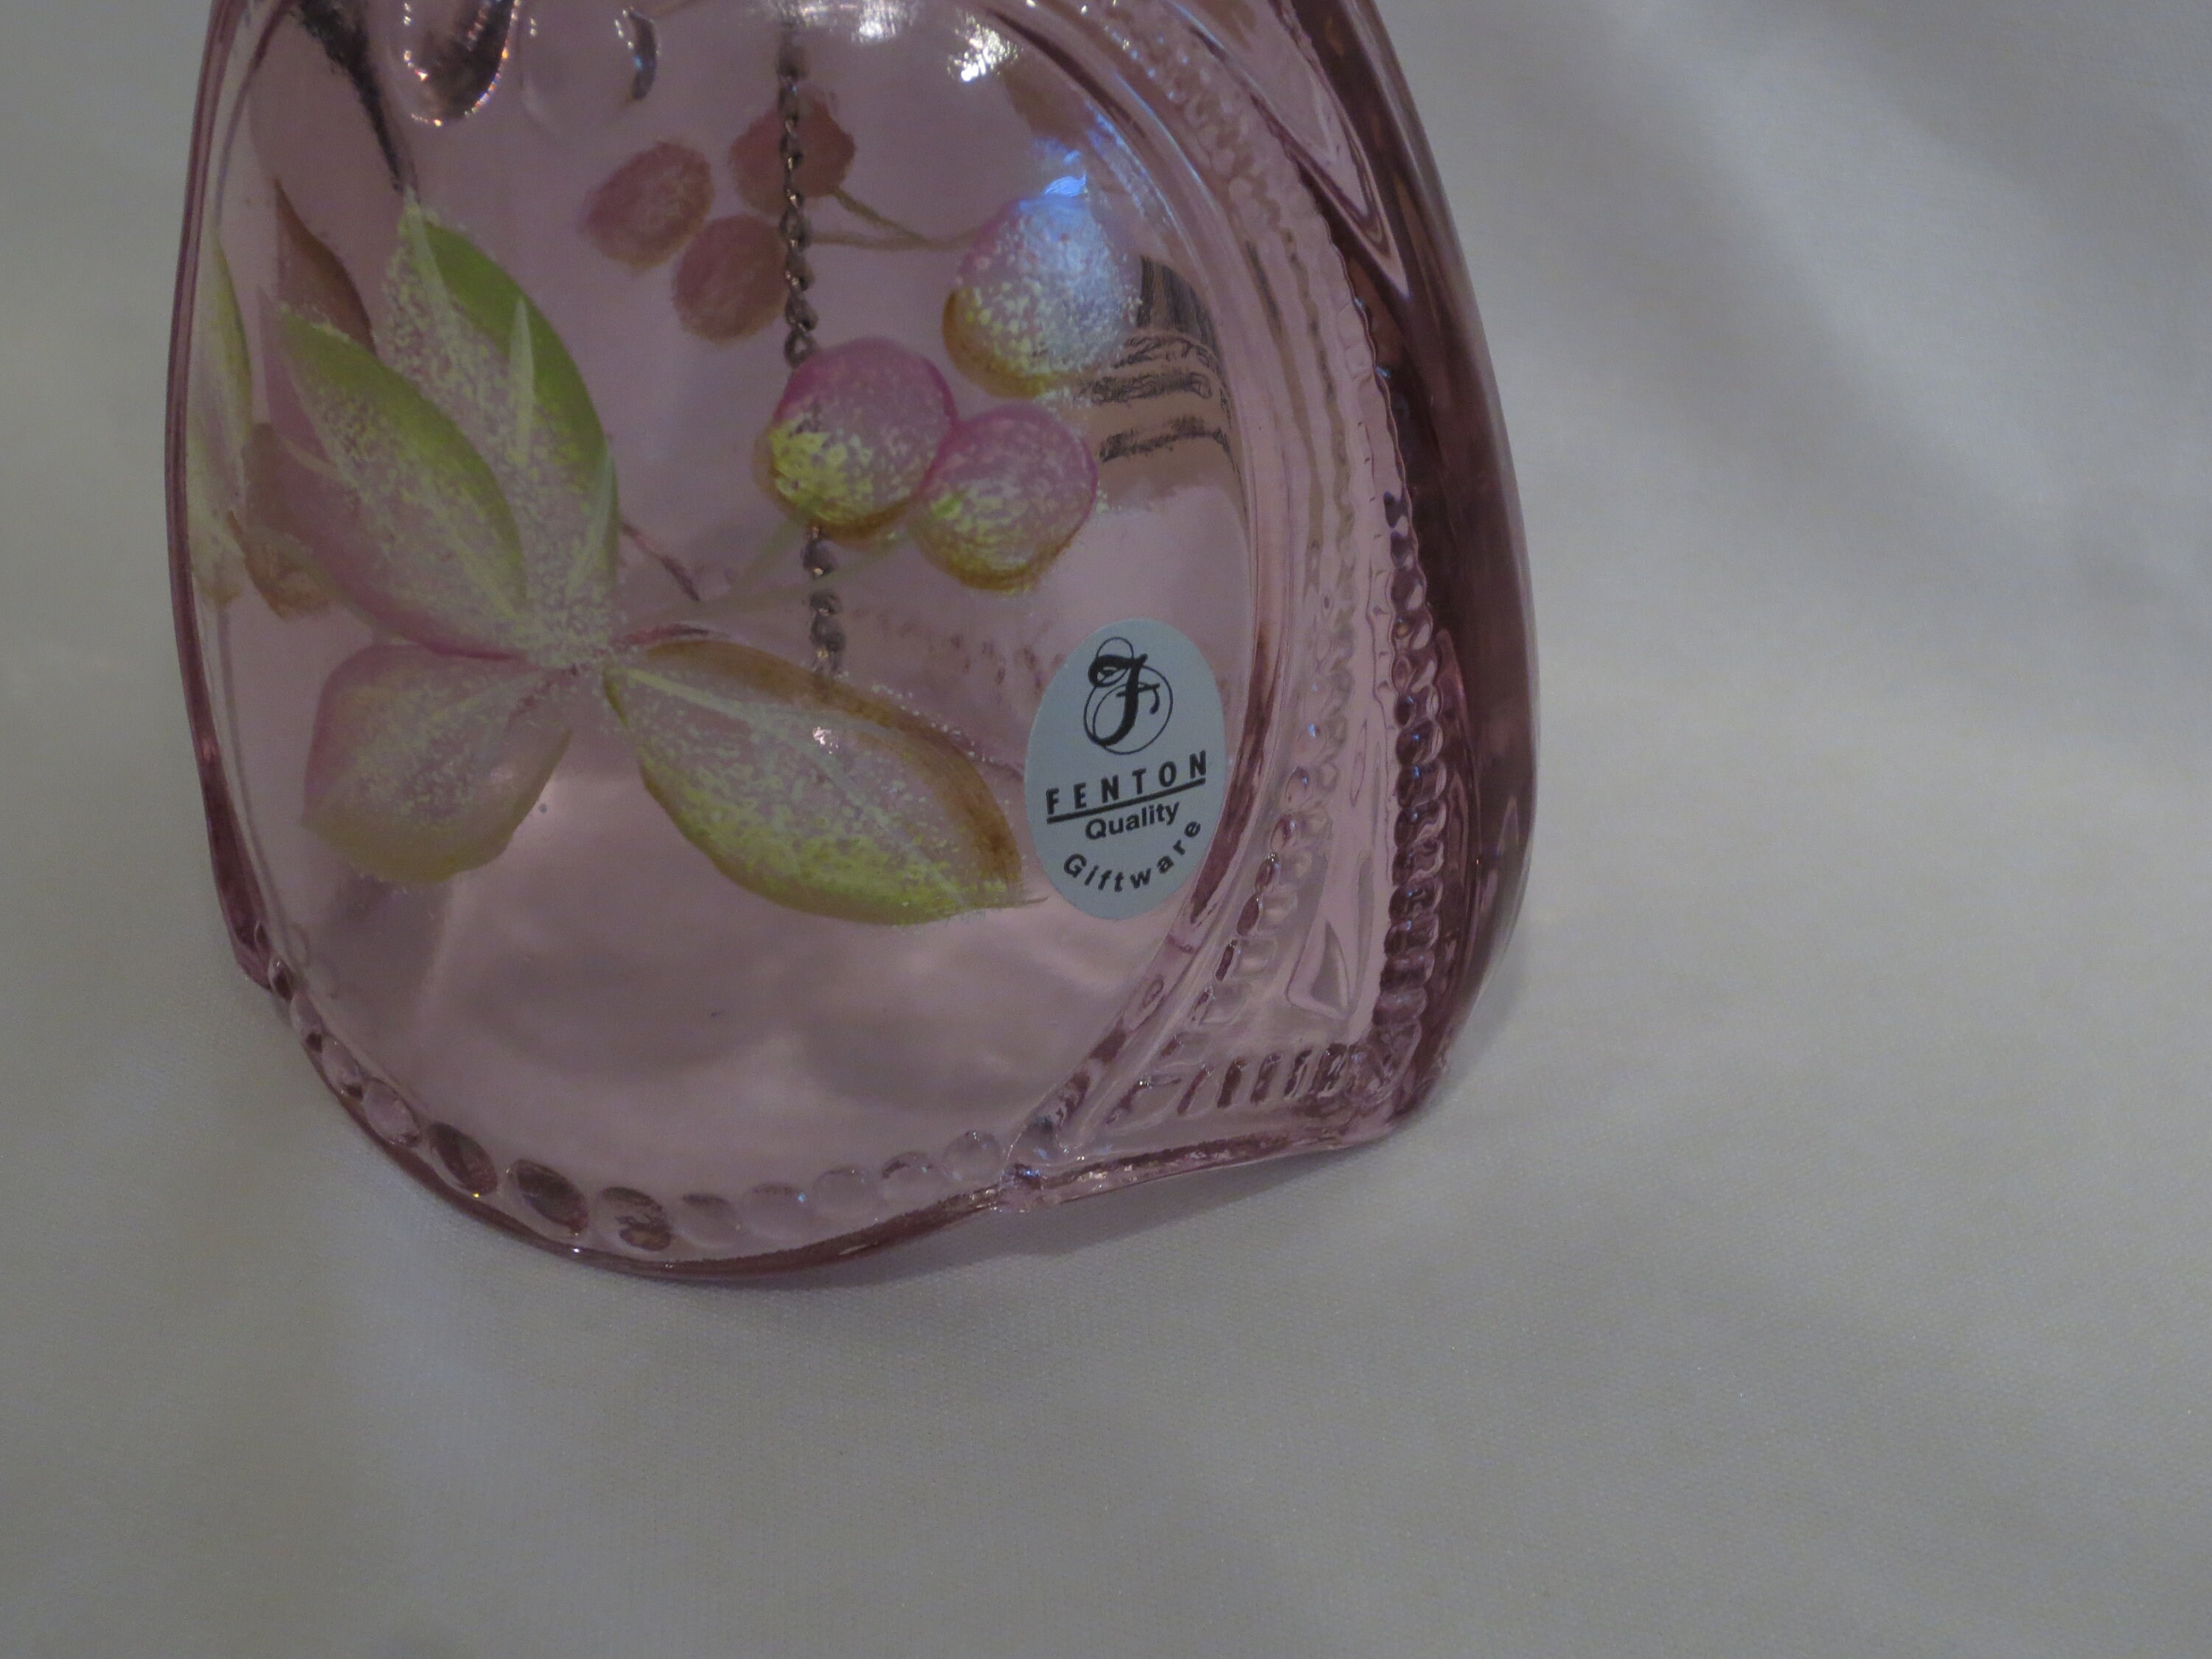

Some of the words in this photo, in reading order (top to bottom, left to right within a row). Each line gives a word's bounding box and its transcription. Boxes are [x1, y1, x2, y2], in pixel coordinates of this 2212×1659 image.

[1046, 749, 1207, 815] FENTON
[1085, 801, 1180, 841] Quality
[1063, 821, 1202, 893] Giftware
